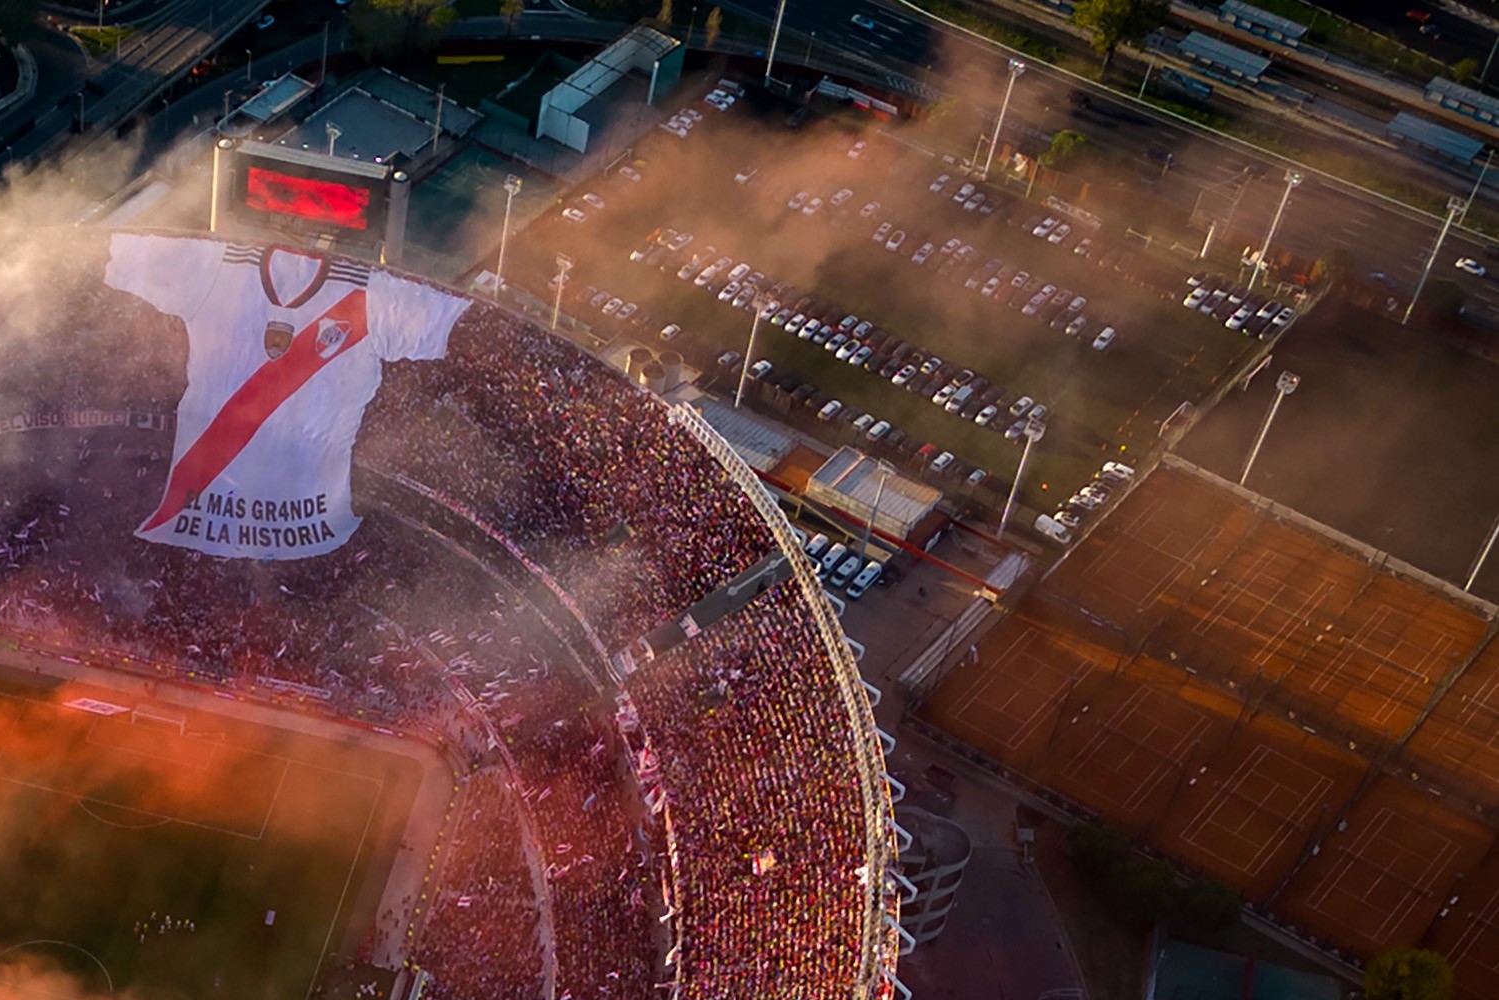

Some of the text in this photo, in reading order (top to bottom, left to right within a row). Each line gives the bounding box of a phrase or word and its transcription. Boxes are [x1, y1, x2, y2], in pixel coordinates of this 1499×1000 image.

[184, 489, 328, 522] EL MÁS GR4NDE
[174, 514, 335, 548] DE LA HISTORIA
